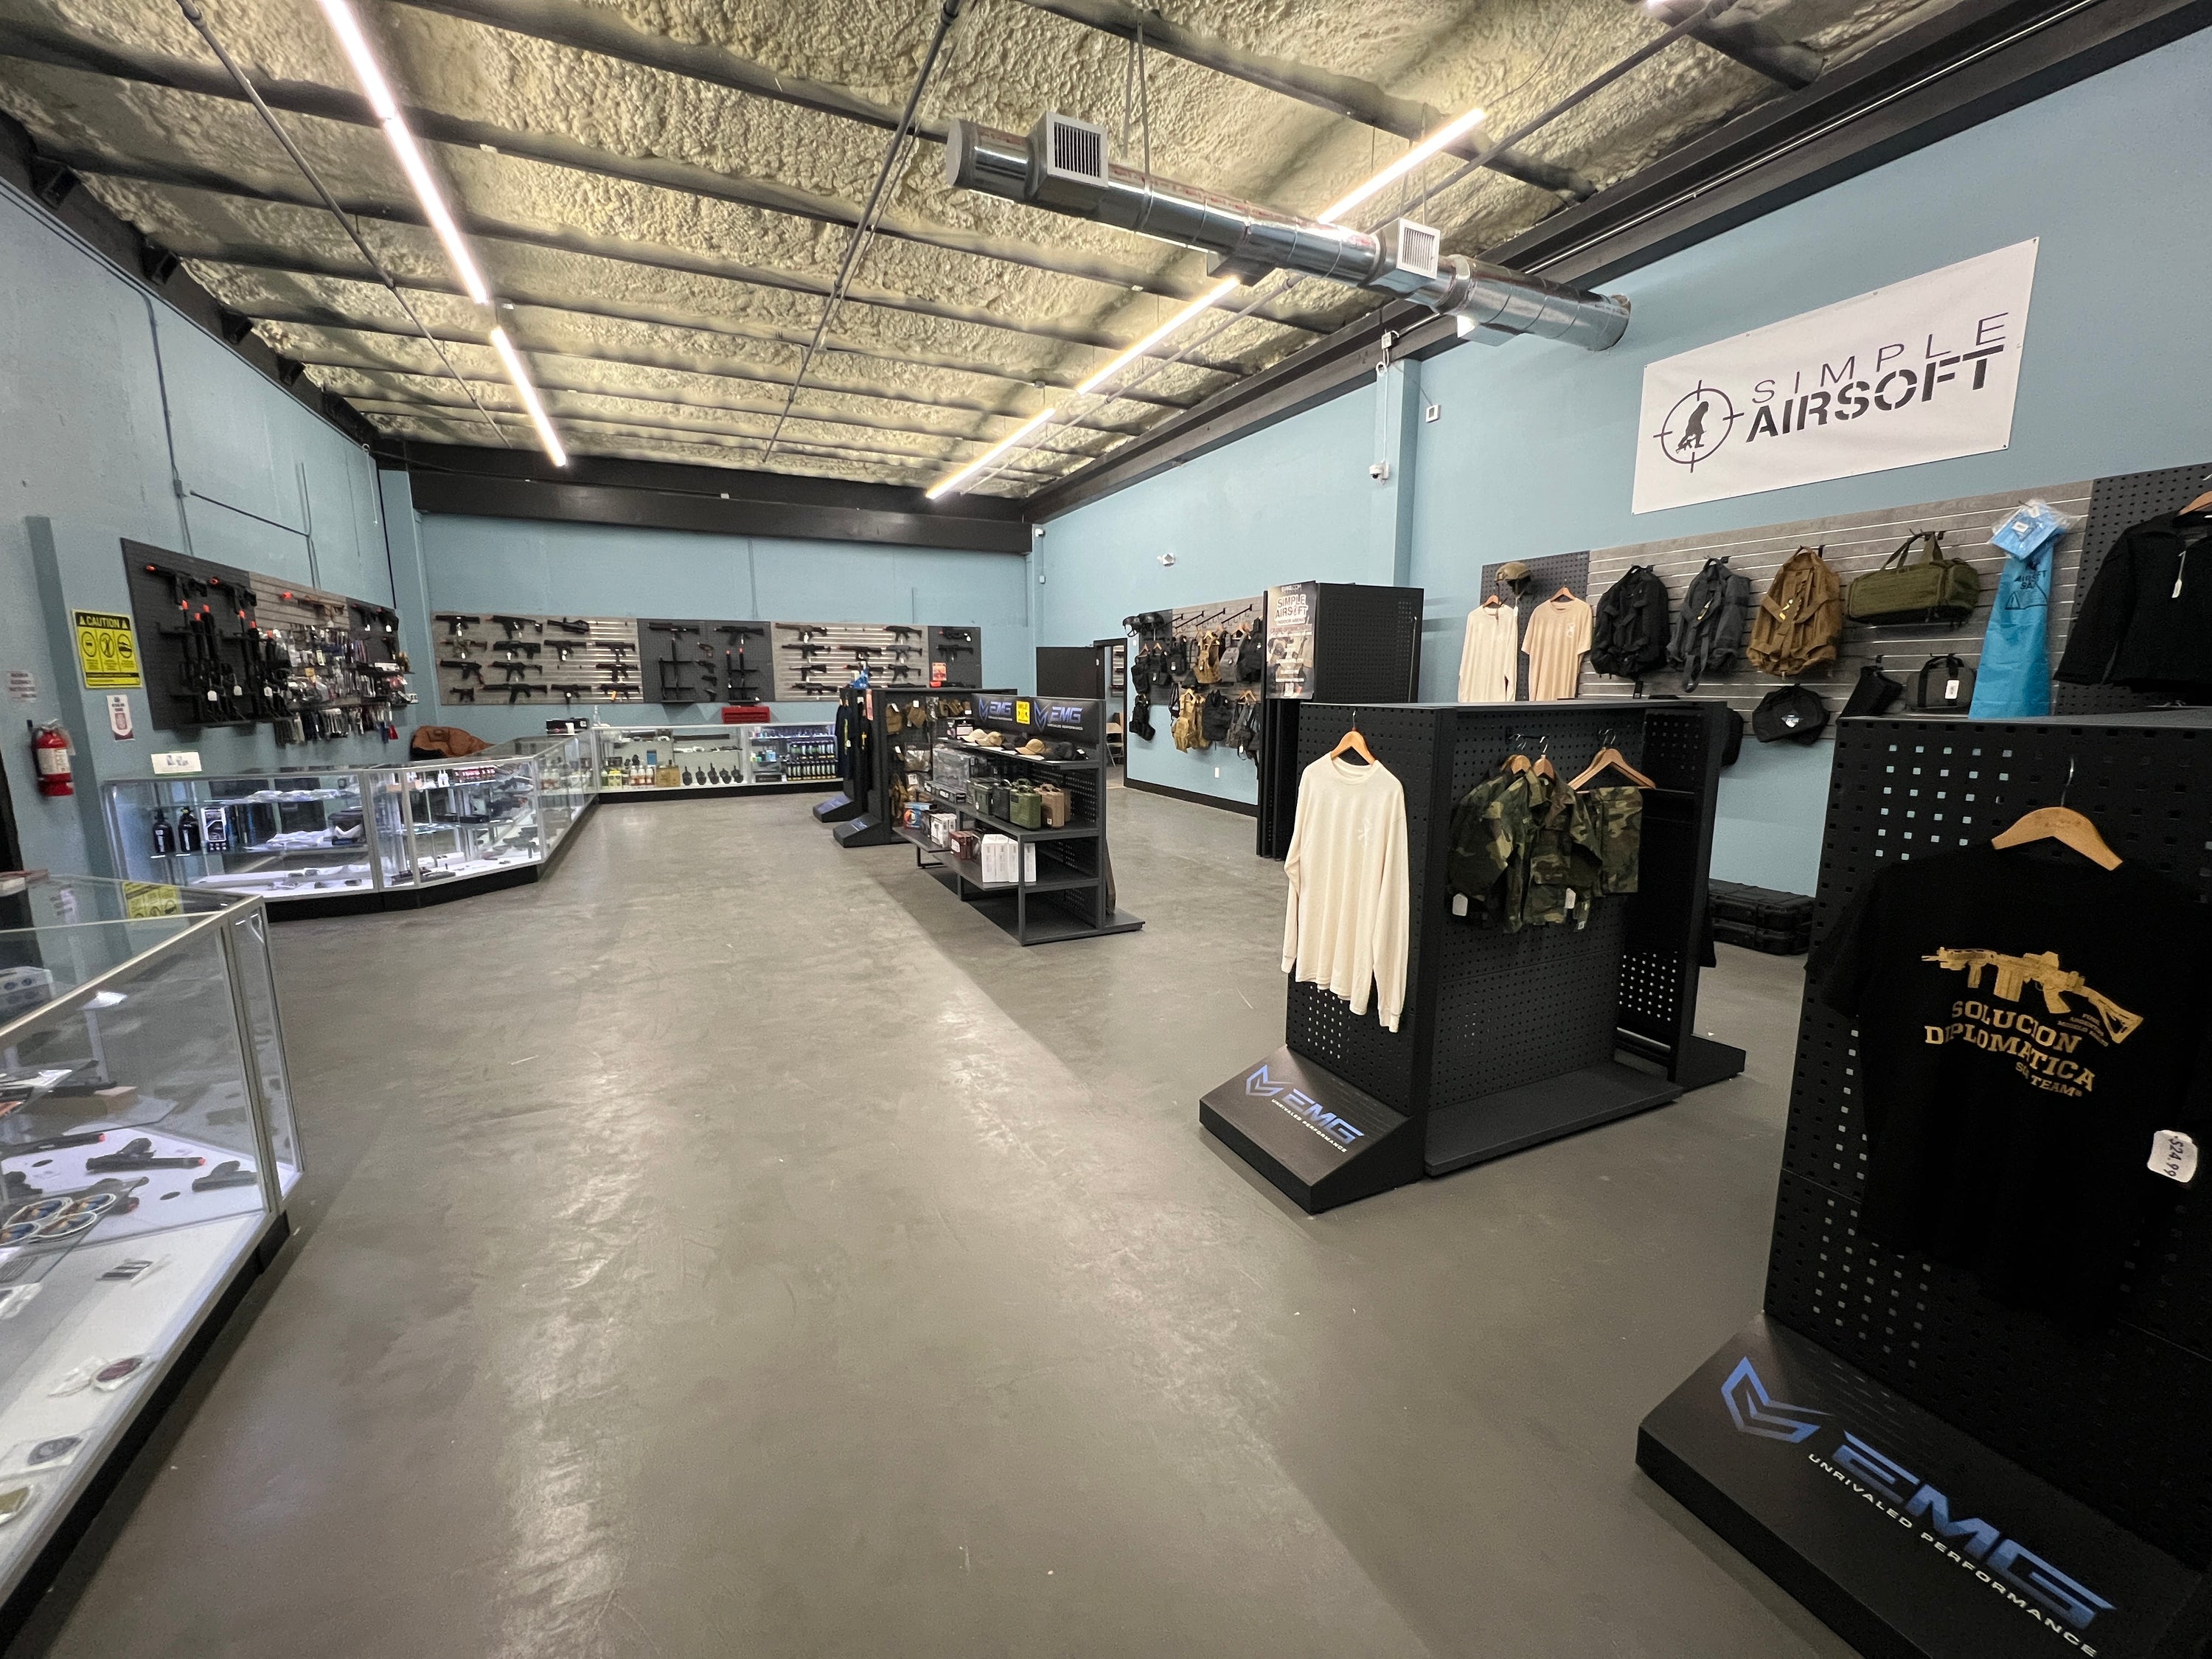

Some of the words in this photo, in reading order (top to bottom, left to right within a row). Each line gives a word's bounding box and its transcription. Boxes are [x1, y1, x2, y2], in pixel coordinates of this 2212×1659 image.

[1751, 312, 2008, 403] SIMPLE
[1745, 344, 2005, 442] AIRSOFT
[86, 616, 120, 628] CAUTION
[1275, 605, 1307, 619] AIRSOFT
[1277, 595, 1305, 608] SIMPLE
[990, 701, 1012, 715] EMG
[1051, 706, 1083, 723] EMG
[1952, 1001, 2082, 1053] SOLUCION
[1924, 1023, 2096, 1091] DIPLOMATICA
[1271, 1099, 1302, 1121] UNRIVALED
[1301, 1121, 1348, 1153] PERFORMANCE
[1282, 1088, 1364, 1144] EMG
[2163, 1137, 2184, 1177] $24.99
[1808, 1453, 1913, 1528] UNRIVALED
[1920, 1531, 2098, 1658] PERFORMANCE
[1832, 1430, 2117, 1630] EMG
